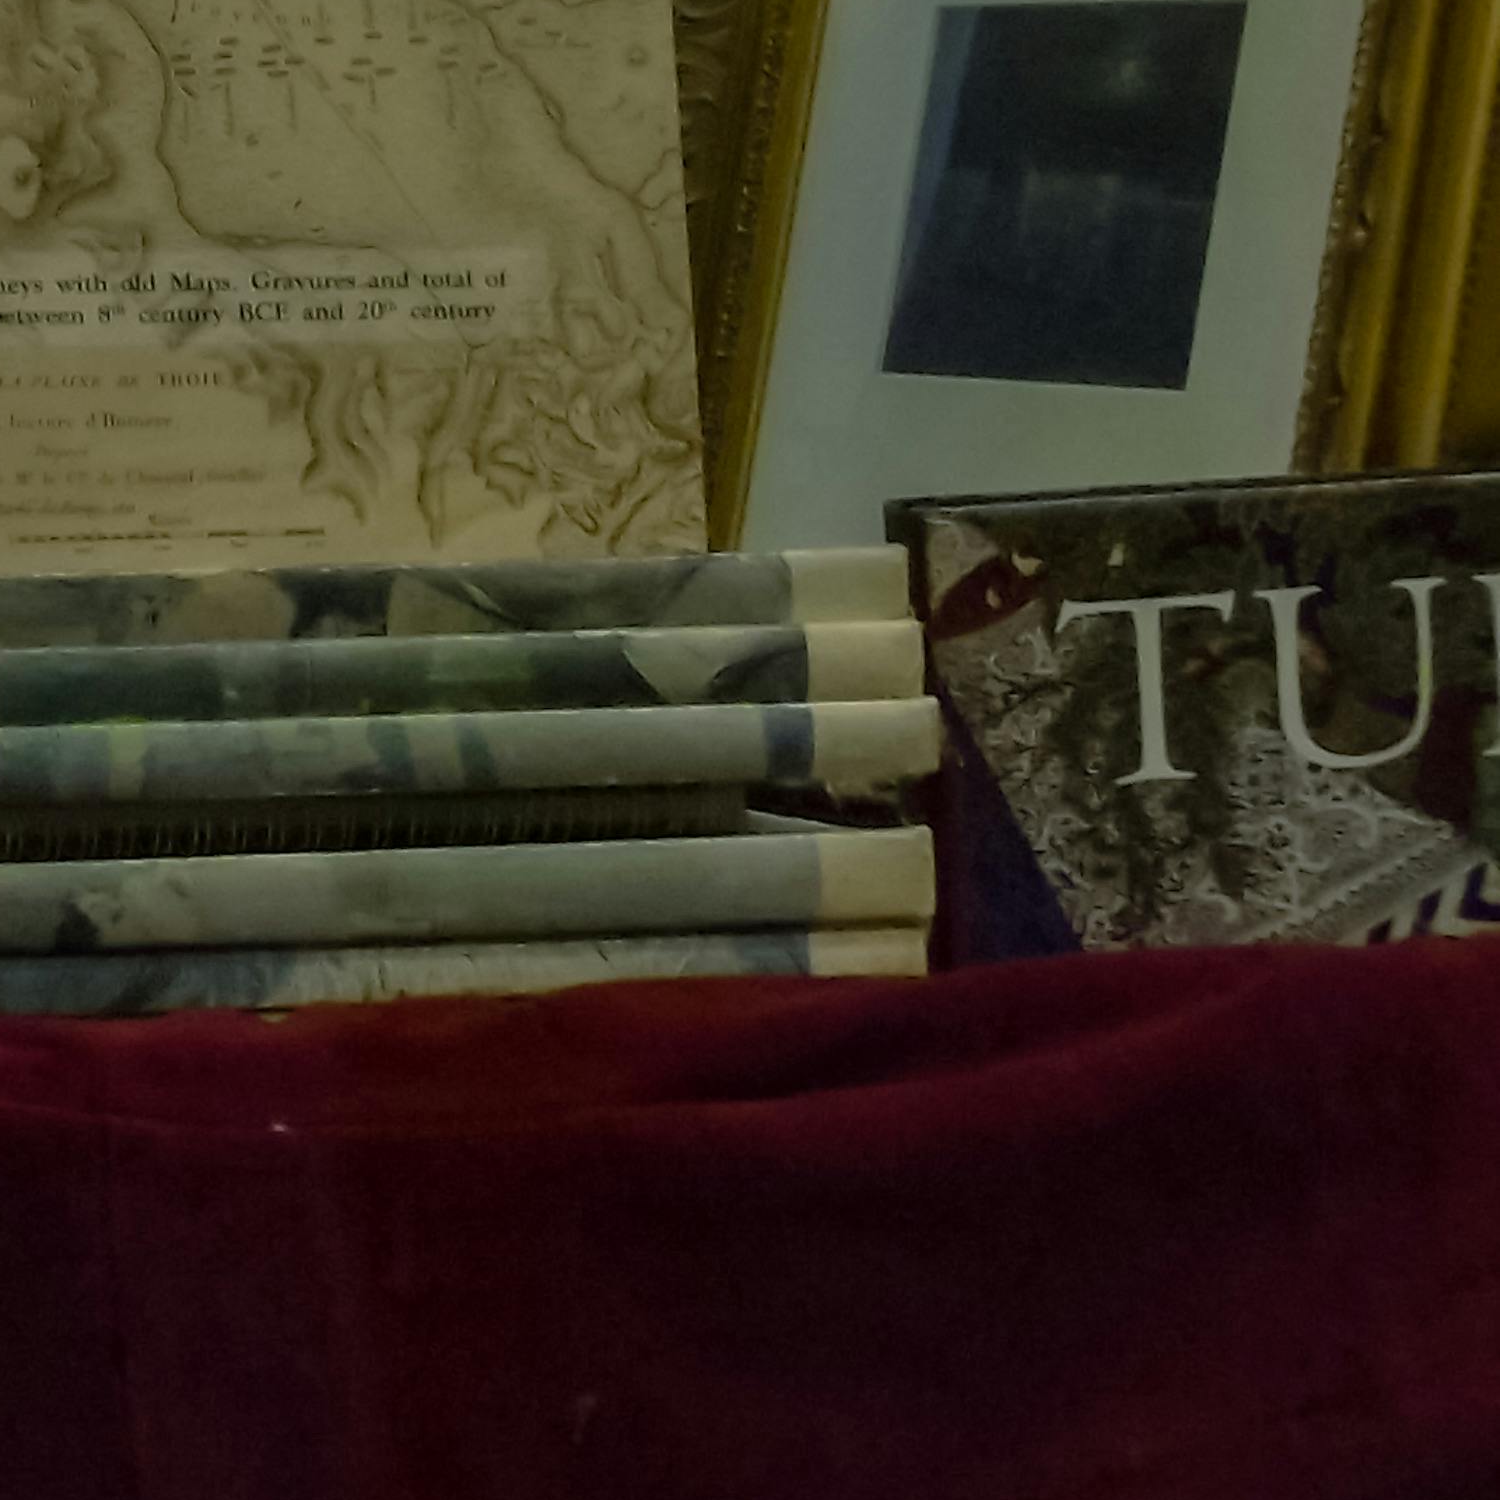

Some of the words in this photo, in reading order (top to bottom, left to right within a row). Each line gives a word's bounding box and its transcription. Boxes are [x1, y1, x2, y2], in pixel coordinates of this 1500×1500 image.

[56, 273, 108, 293] with
[120, 273, 156, 293] old
[250, 270, 357, 291] Gravures
[368, 270, 409, 289] and
[422, 270, 473, 289] total
[484, 270, 507, 289] of
[138, 306, 225, 326] century
[238, 301, 289, 322] BCE
[302, 301, 344, 322] and
[410, 303, 497, 324] century
[1054, 570, 1500, 790] TU
